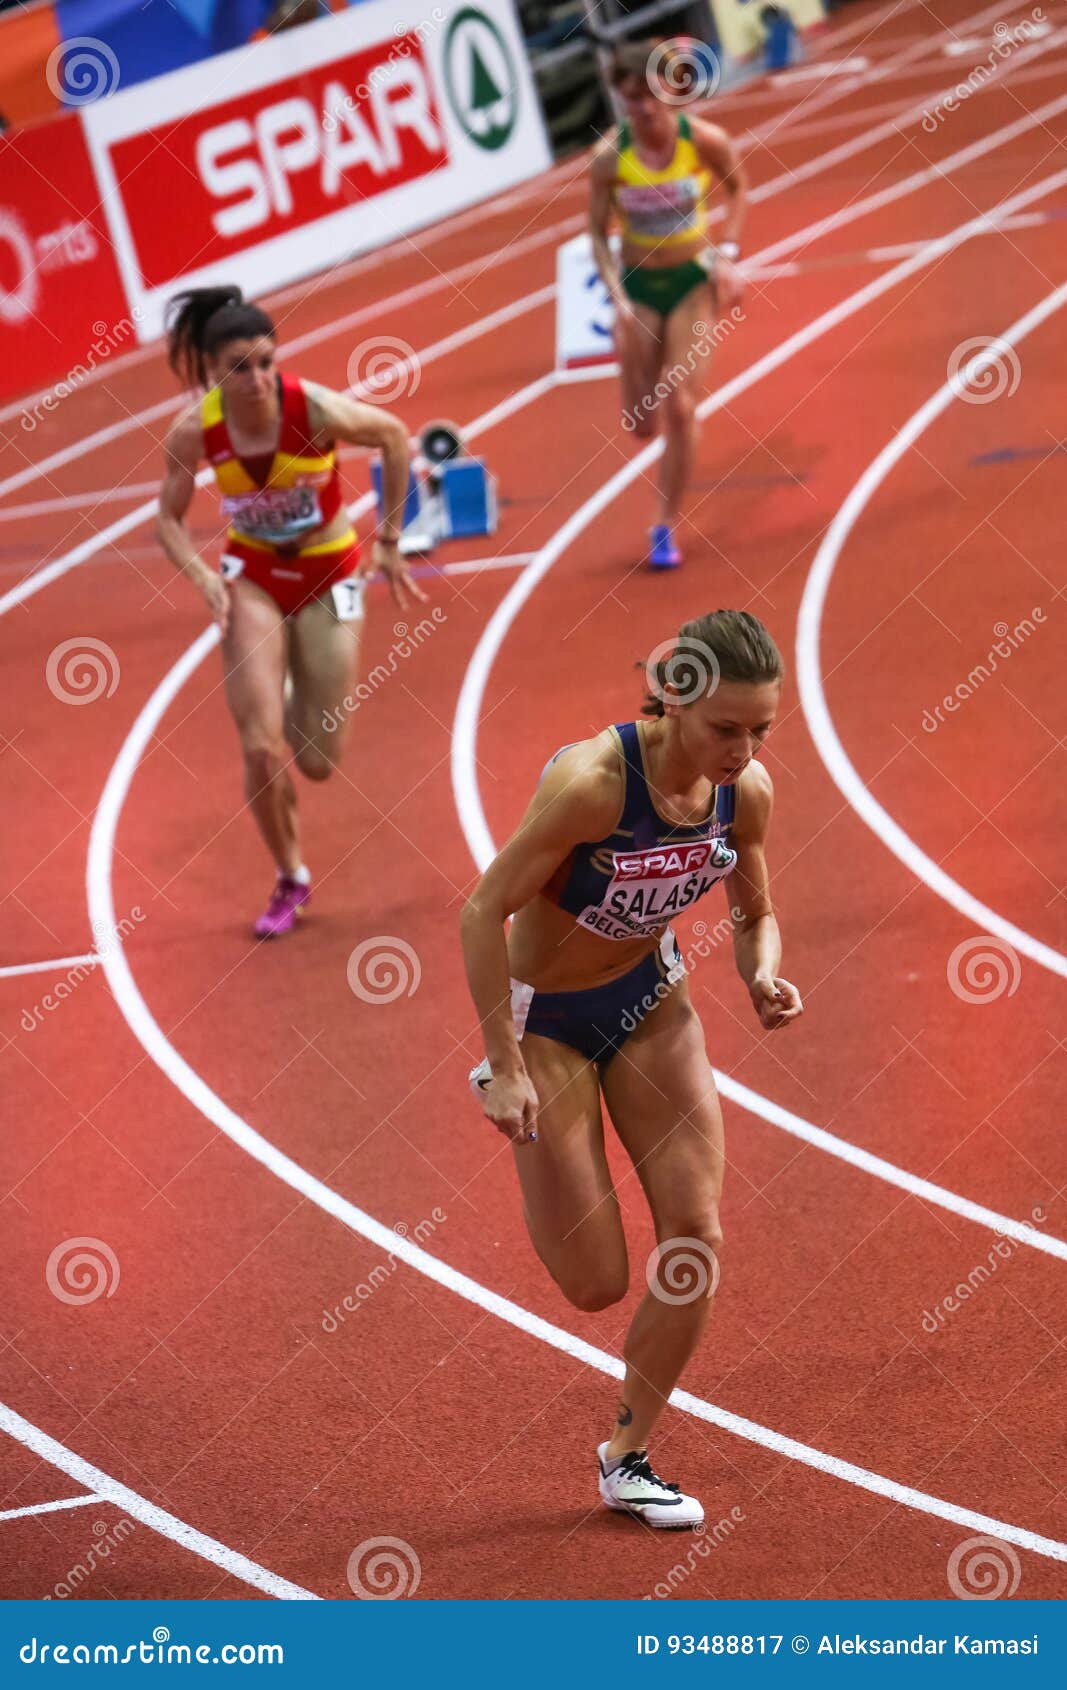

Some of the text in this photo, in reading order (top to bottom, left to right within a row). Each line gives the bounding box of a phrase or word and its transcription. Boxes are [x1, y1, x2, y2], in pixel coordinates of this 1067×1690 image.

[195, 56, 441, 237] SPAR
[619, 847, 708, 879] SPAR
[605, 871, 726, 918] SALAŠK
